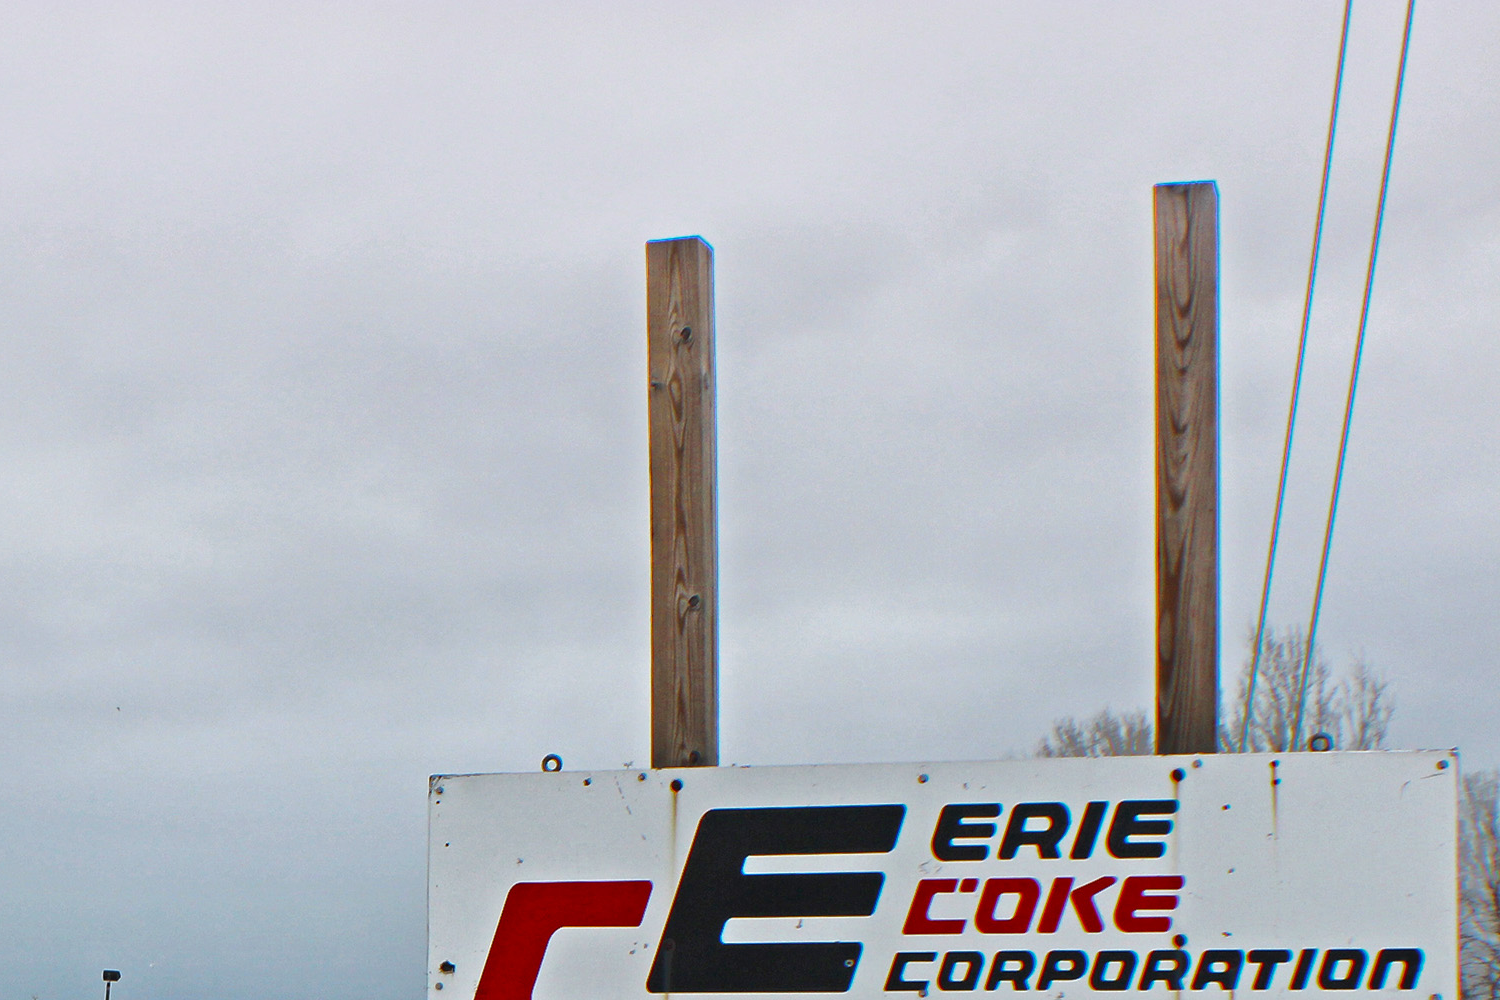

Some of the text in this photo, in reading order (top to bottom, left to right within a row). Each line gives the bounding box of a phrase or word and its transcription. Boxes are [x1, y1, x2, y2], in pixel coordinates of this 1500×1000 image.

[930, 800, 1180, 862] ERIE
[901, 875, 1186, 935] COKE
[884, 948, 1424, 993] CORPORATION
